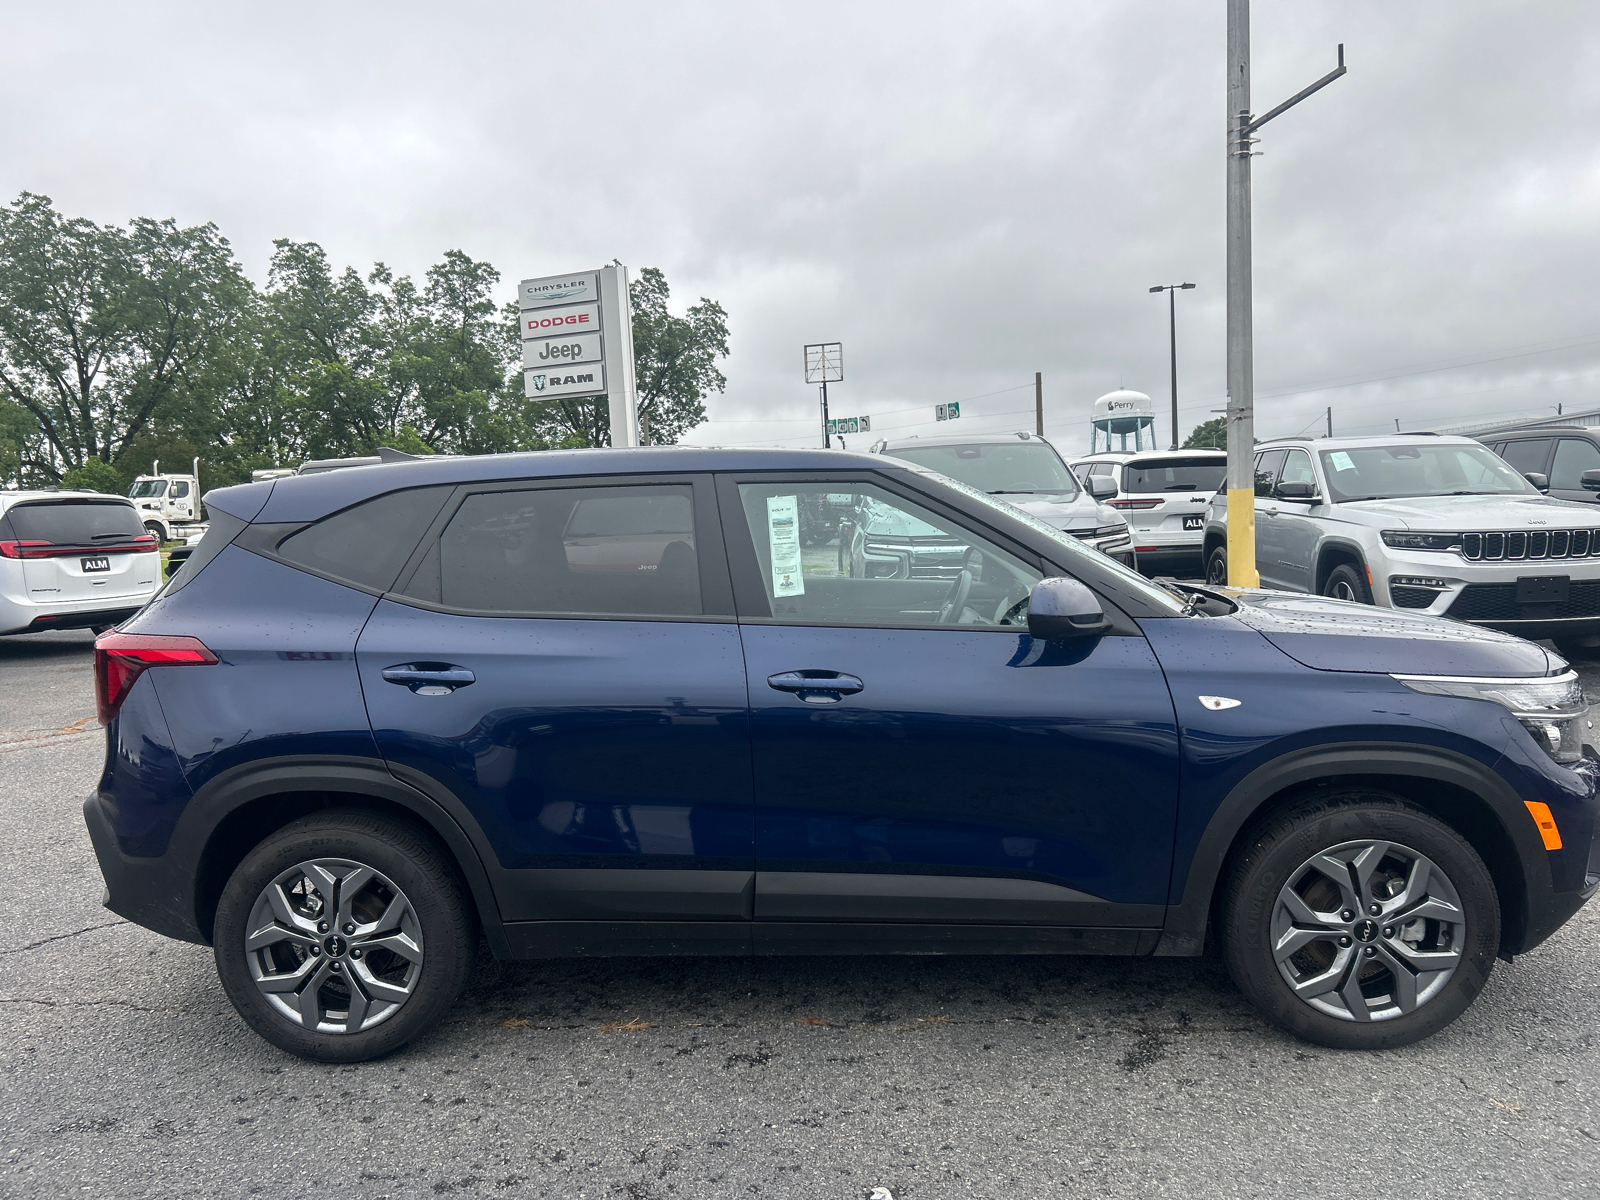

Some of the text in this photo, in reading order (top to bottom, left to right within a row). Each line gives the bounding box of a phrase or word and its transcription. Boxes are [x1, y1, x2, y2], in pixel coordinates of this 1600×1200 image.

[527, 280, 586, 294] CHRYSLER
[527, 313, 590, 330] DODGE
[538, 342, 582, 360] Jeep
[549, 373, 594, 386] RAM
[1114, 401, 1134, 410] Perry
[85, 560, 108, 570] ALM
[1247, 869, 1275, 950] KUMHO
